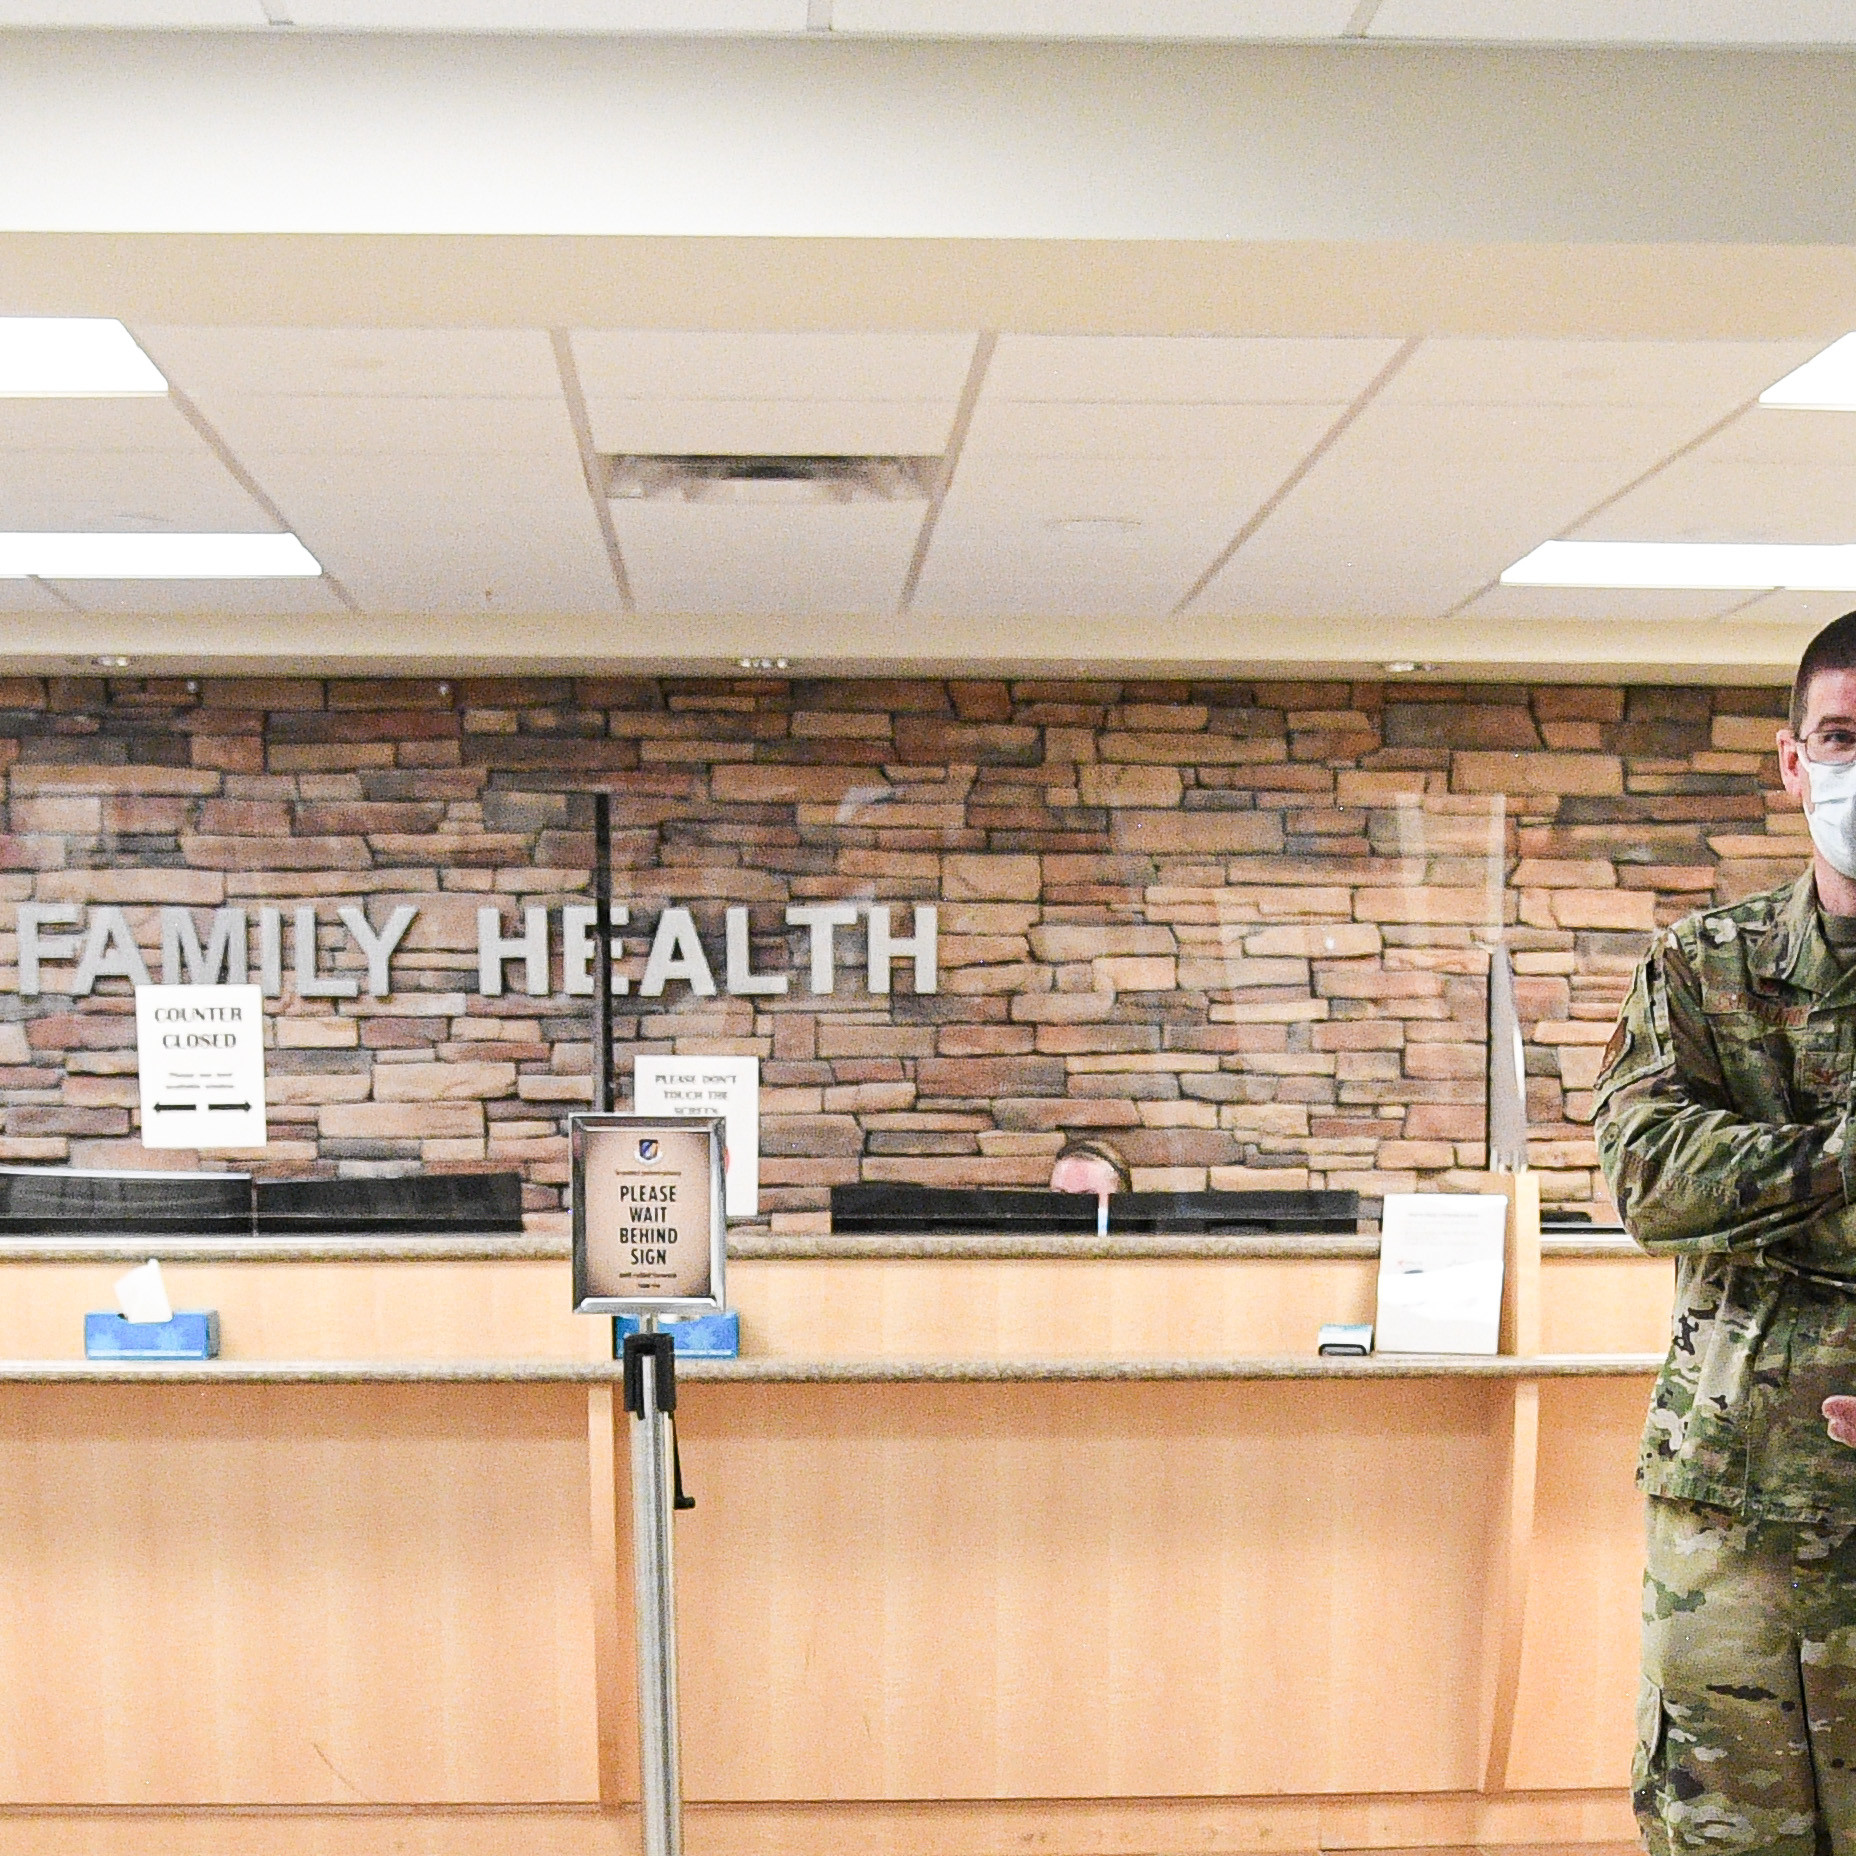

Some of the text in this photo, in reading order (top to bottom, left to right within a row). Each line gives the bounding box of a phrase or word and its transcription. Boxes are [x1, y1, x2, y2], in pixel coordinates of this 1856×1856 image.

[17, 904, 938, 998] FAMILY HEALTH
[154, 1007, 243, 1022] COUNTER
[162, 1034, 237, 1048] CLOSED
[620, 1185, 677, 1202] PLEASE
[629, 1206, 667, 1223] WAIT
[619, 1227, 678, 1244] BEHIND
[631, 1248, 666, 1265] SIGN
